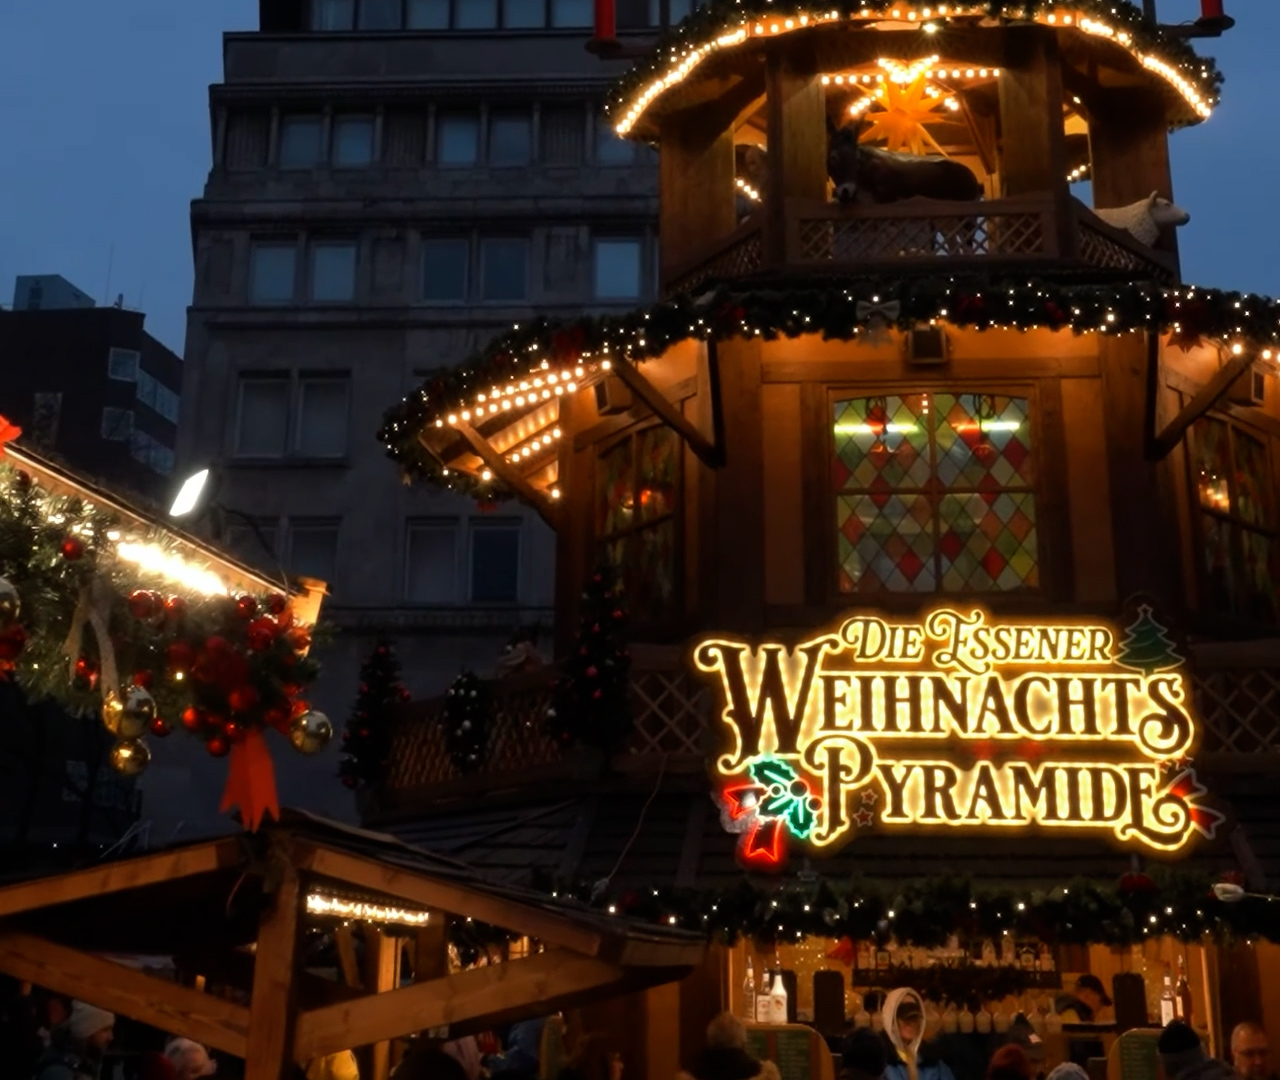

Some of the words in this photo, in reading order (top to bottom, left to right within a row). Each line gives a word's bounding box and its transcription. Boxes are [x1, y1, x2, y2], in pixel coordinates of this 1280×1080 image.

[840, 617, 923, 662] DIE
[924, 608, 1115, 675] ESSENER
[695, 636, 1194, 775] WEIHNACHTS
[803, 735, 1194, 851] PYRAMIDE
